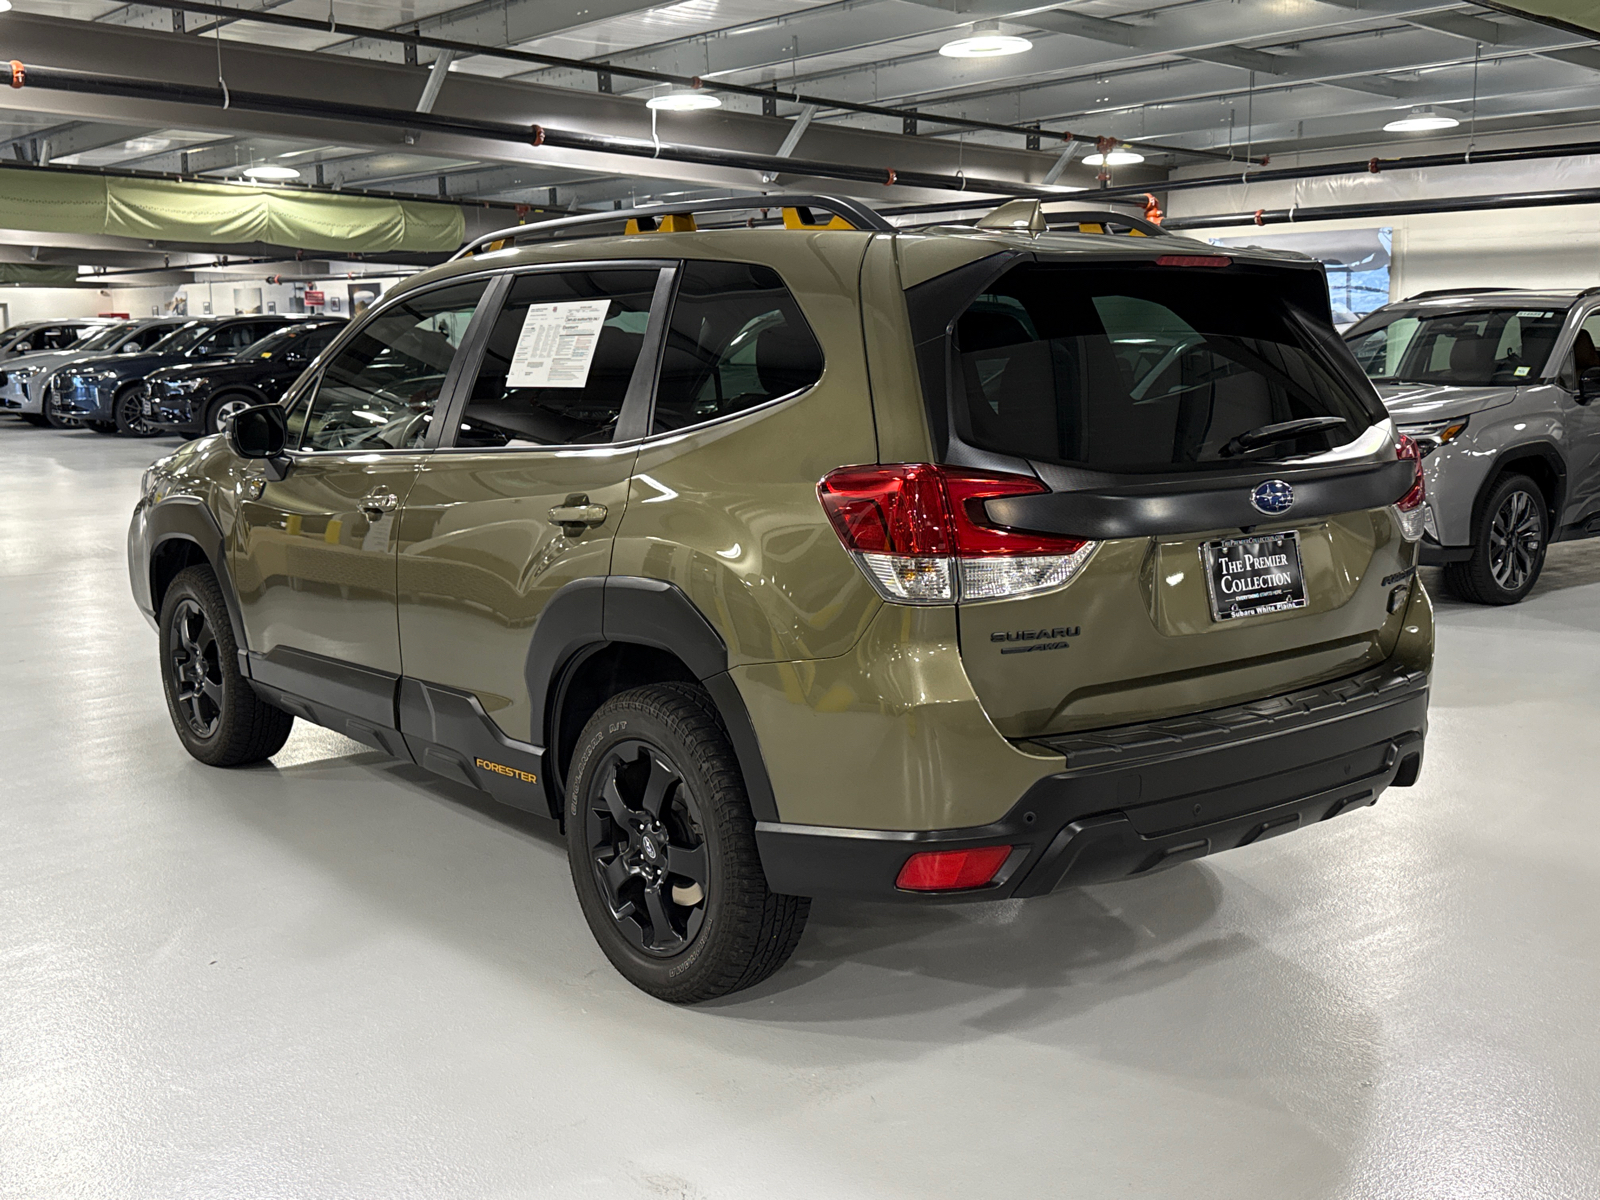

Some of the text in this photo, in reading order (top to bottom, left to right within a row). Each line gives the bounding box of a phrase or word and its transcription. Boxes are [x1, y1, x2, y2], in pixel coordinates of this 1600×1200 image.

[1231, 607, 1255, 618] Subaru
[1256, 605, 1274, 614] White
[990, 626, 1081, 643] SUBARU
[1027, 641, 1069, 651] AWD
[608, 720, 628, 734] A/T
[476, 758, 538, 785] FORESTER
